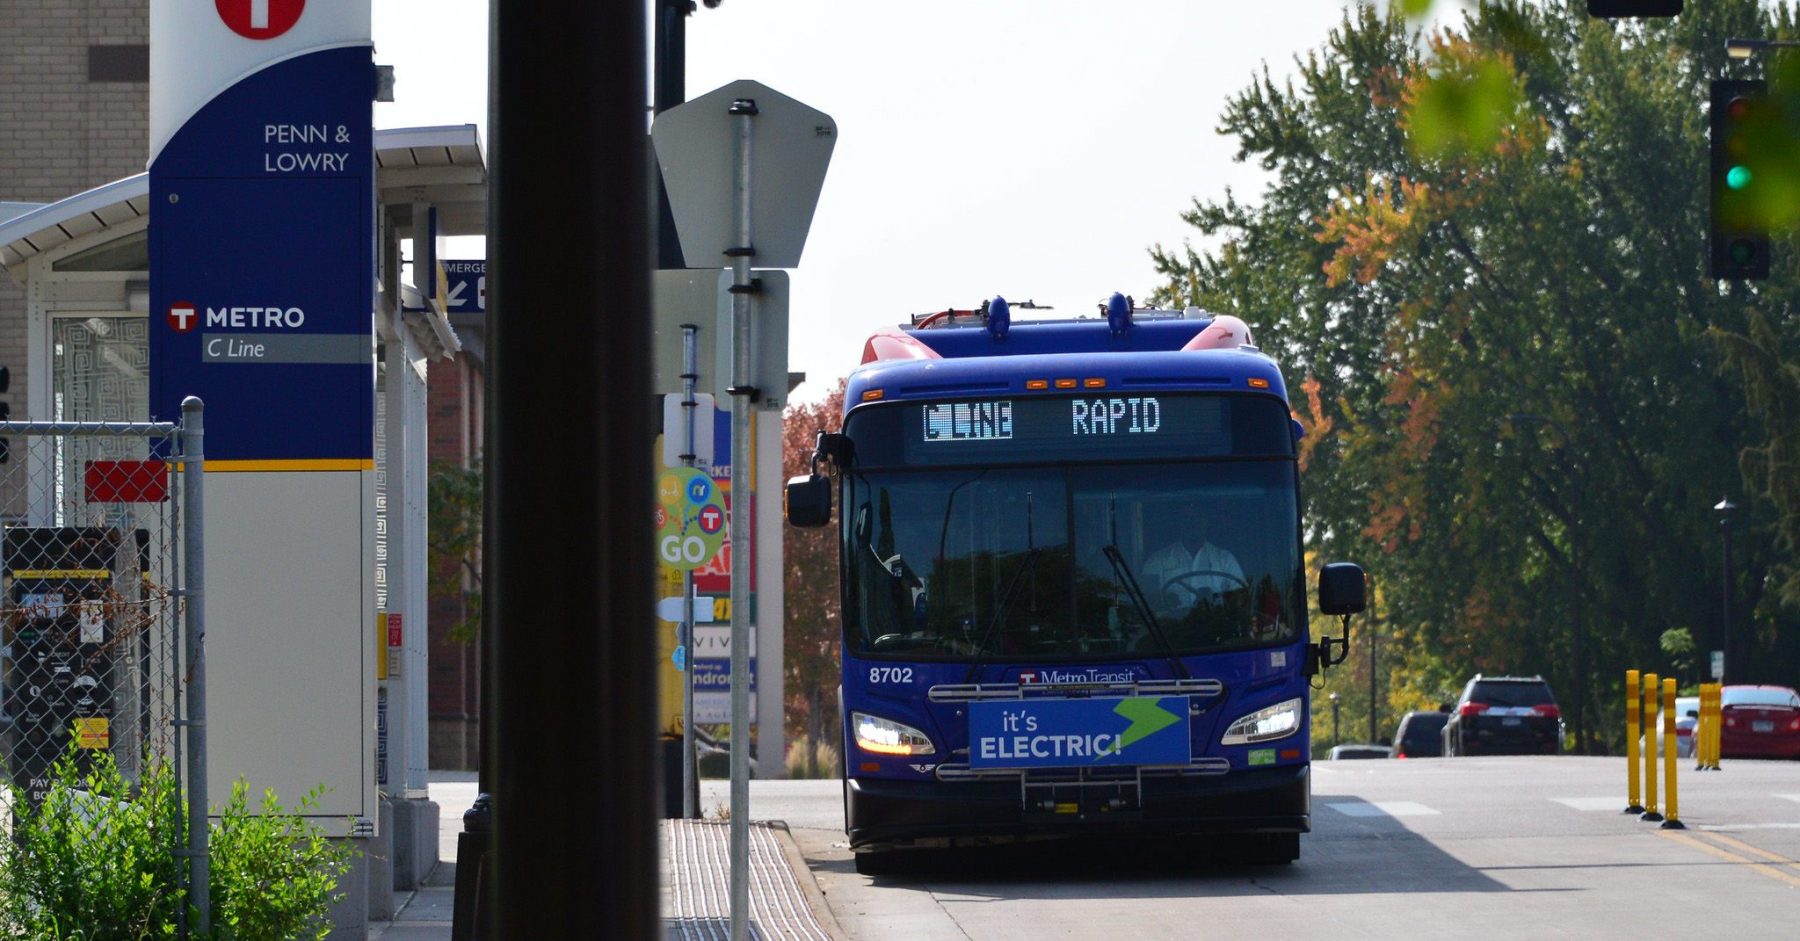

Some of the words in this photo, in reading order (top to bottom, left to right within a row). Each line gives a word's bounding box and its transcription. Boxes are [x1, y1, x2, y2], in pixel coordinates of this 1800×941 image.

[265, 124, 328, 143] PENN
[335, 124, 350, 143] &
[265, 153, 350, 172] LOWRY
[206, 307, 305, 328] METRO
[207, 338, 223, 357] C
[227, 339, 265, 357] Line
[951, 402, 1012, 438] LINE
[1072, 398, 1160, 434] RAPID
[661, 536, 706, 562] GO
[869, 667, 913, 684] 8702
[1003, 710, 1038, 732] it's
[980, 734, 1122, 759] ELECTRIC!
[30, 779, 49, 787] PAY
